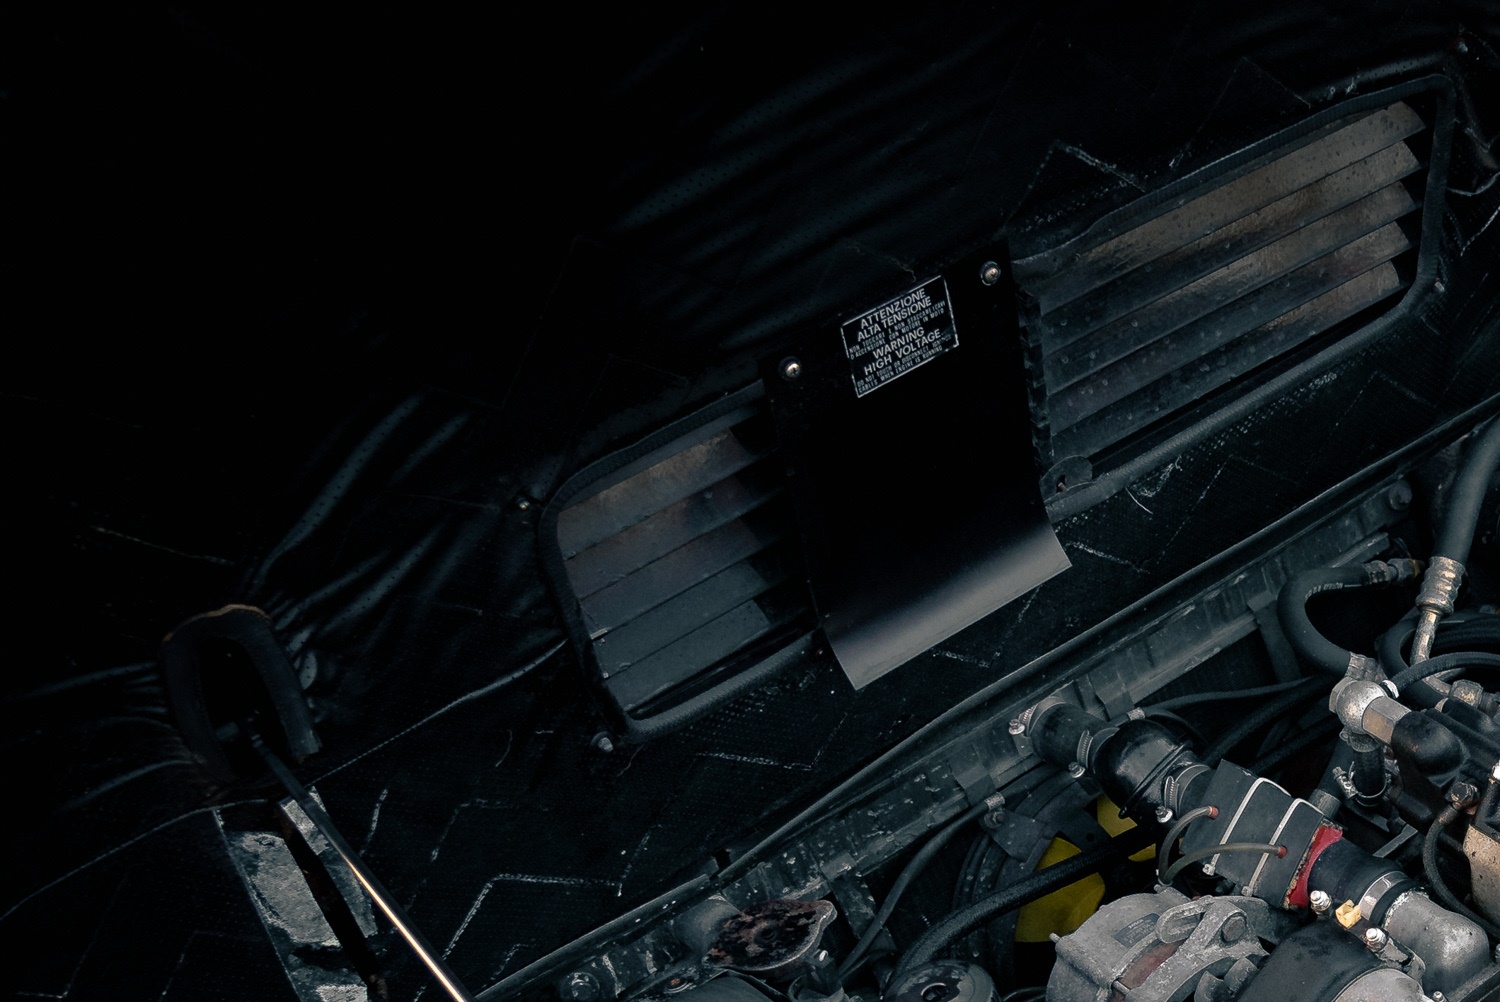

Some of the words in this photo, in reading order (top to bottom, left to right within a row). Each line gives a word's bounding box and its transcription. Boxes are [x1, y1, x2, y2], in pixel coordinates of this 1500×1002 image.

[858, 324, 881, 341] ALTA
[881, 296, 932, 328] TENSIONE
[861, 288, 926, 329] ATTENZIONE
[849, 345, 860, 354] NON
[864, 354, 892, 375] HIGH
[895, 329, 941, 358] VOLTAGE
[873, 327, 925, 359] WARNING
